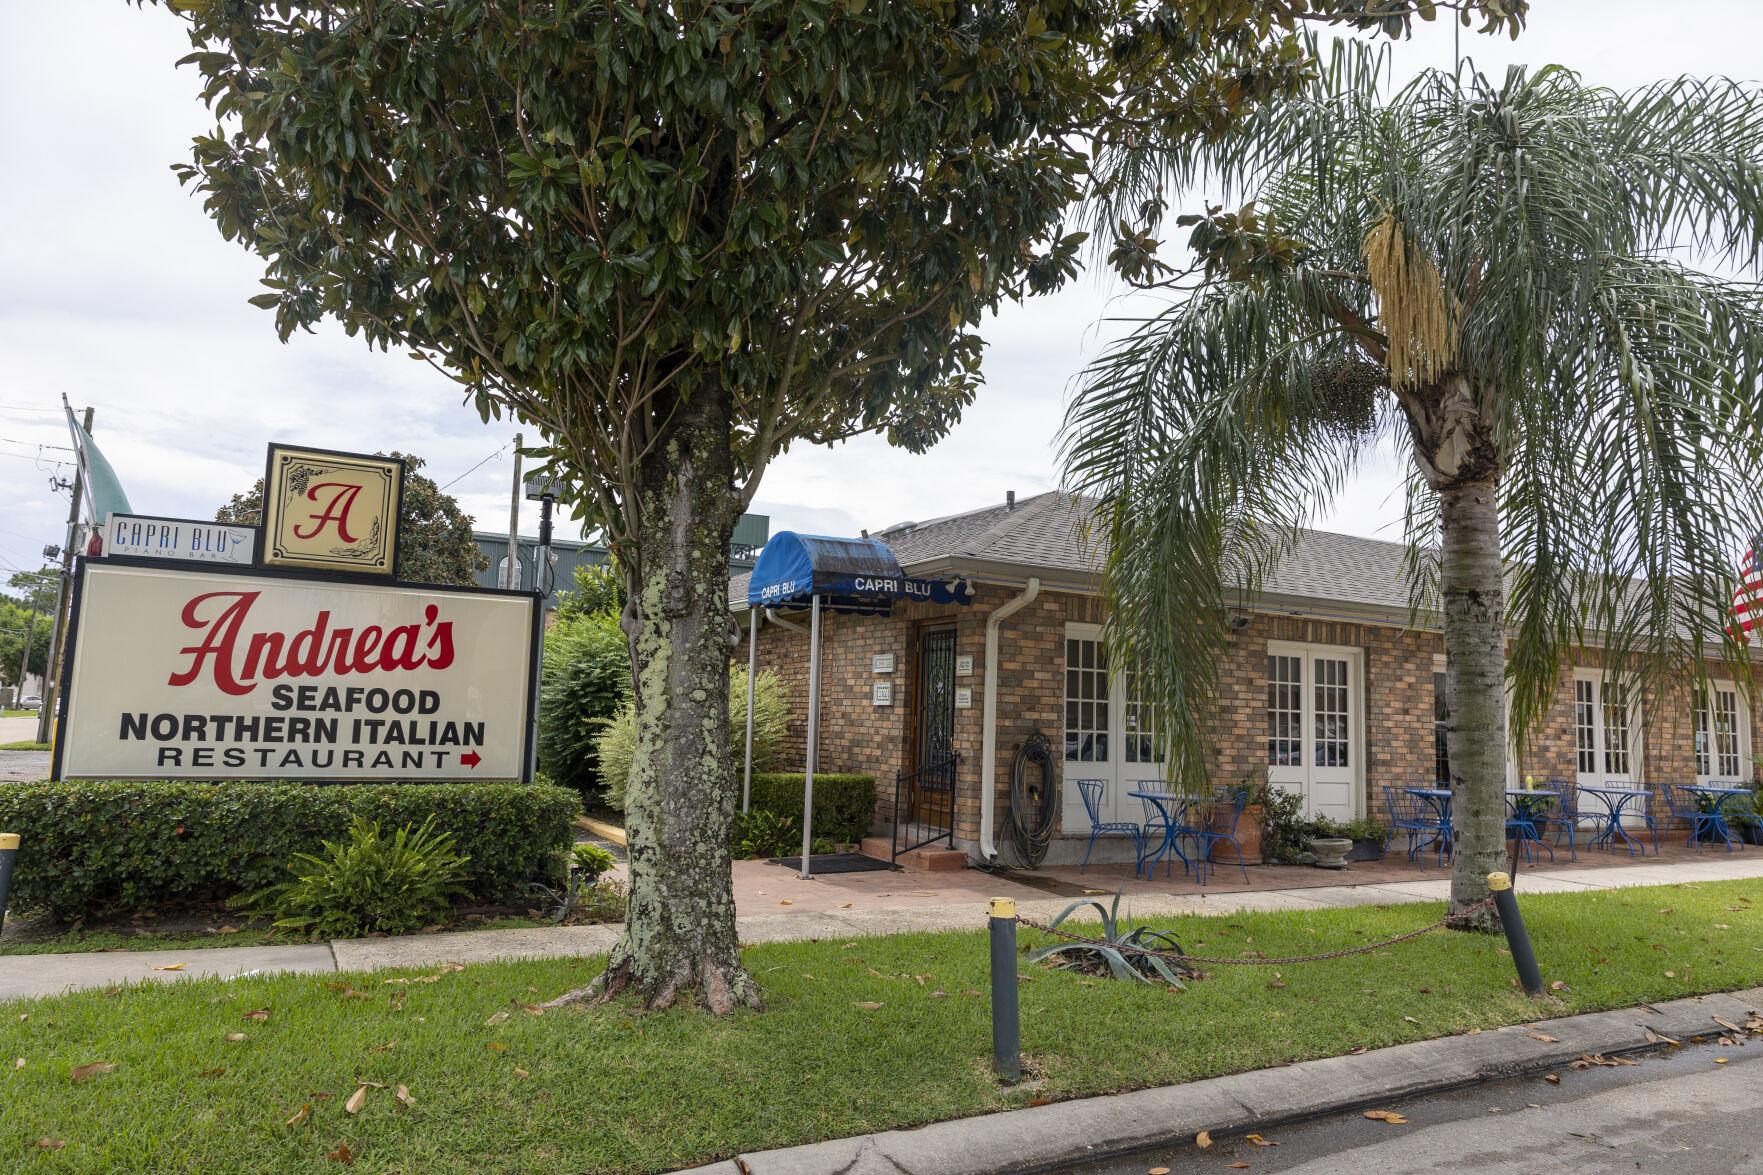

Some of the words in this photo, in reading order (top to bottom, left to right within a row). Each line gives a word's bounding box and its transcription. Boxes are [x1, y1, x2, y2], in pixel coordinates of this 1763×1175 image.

[293, 482, 363, 543] A
[117, 521, 179, 549] CAPRI
[192, 528, 226, 552] BLU
[124, 547, 175, 556] PIANO
[189, 551, 217, 559] BAR
[761, 584, 780, 599] CAPRI
[782, 580, 796, 594] BLU
[854, 577, 898, 592] CAPRI
[905, 580, 931, 596] BLU
[167, 590, 455, 696] Andrea's
[271, 684, 441, 715] SEAFOOD
[119, 712, 339, 744] NORTHERN
[351, 718, 485, 746] ITALIAN
[157, 746, 451, 769] RESTAURANT
